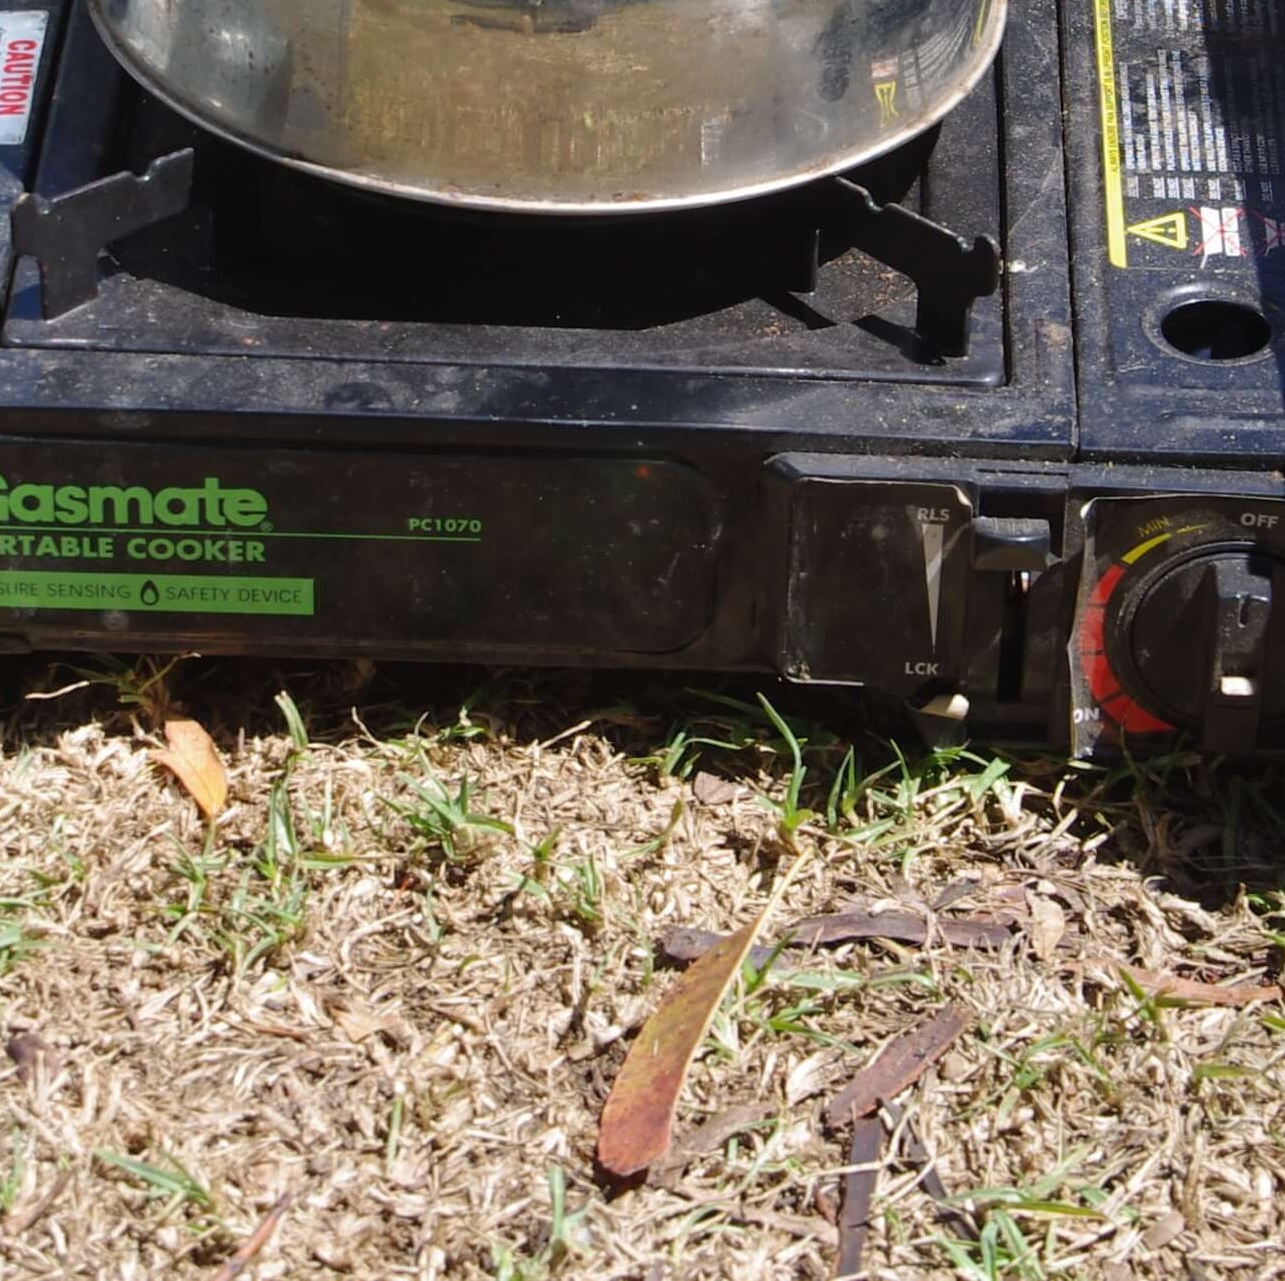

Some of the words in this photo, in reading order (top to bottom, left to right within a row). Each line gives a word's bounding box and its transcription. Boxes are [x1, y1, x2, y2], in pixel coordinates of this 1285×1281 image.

[917, 507, 950, 521] RLS
[1240, 512, 1279, 528] OFF
[408, 518, 482, 533] PC1070
[1137, 515, 1171, 538] MIN
[127, 538, 266, 562] COOKER
[46, 584, 132, 599] SENSING
[165, 586, 230, 602] SAFETY
[237, 588, 302, 604] DEVICE
[905, 661, 940, 676] LCK
